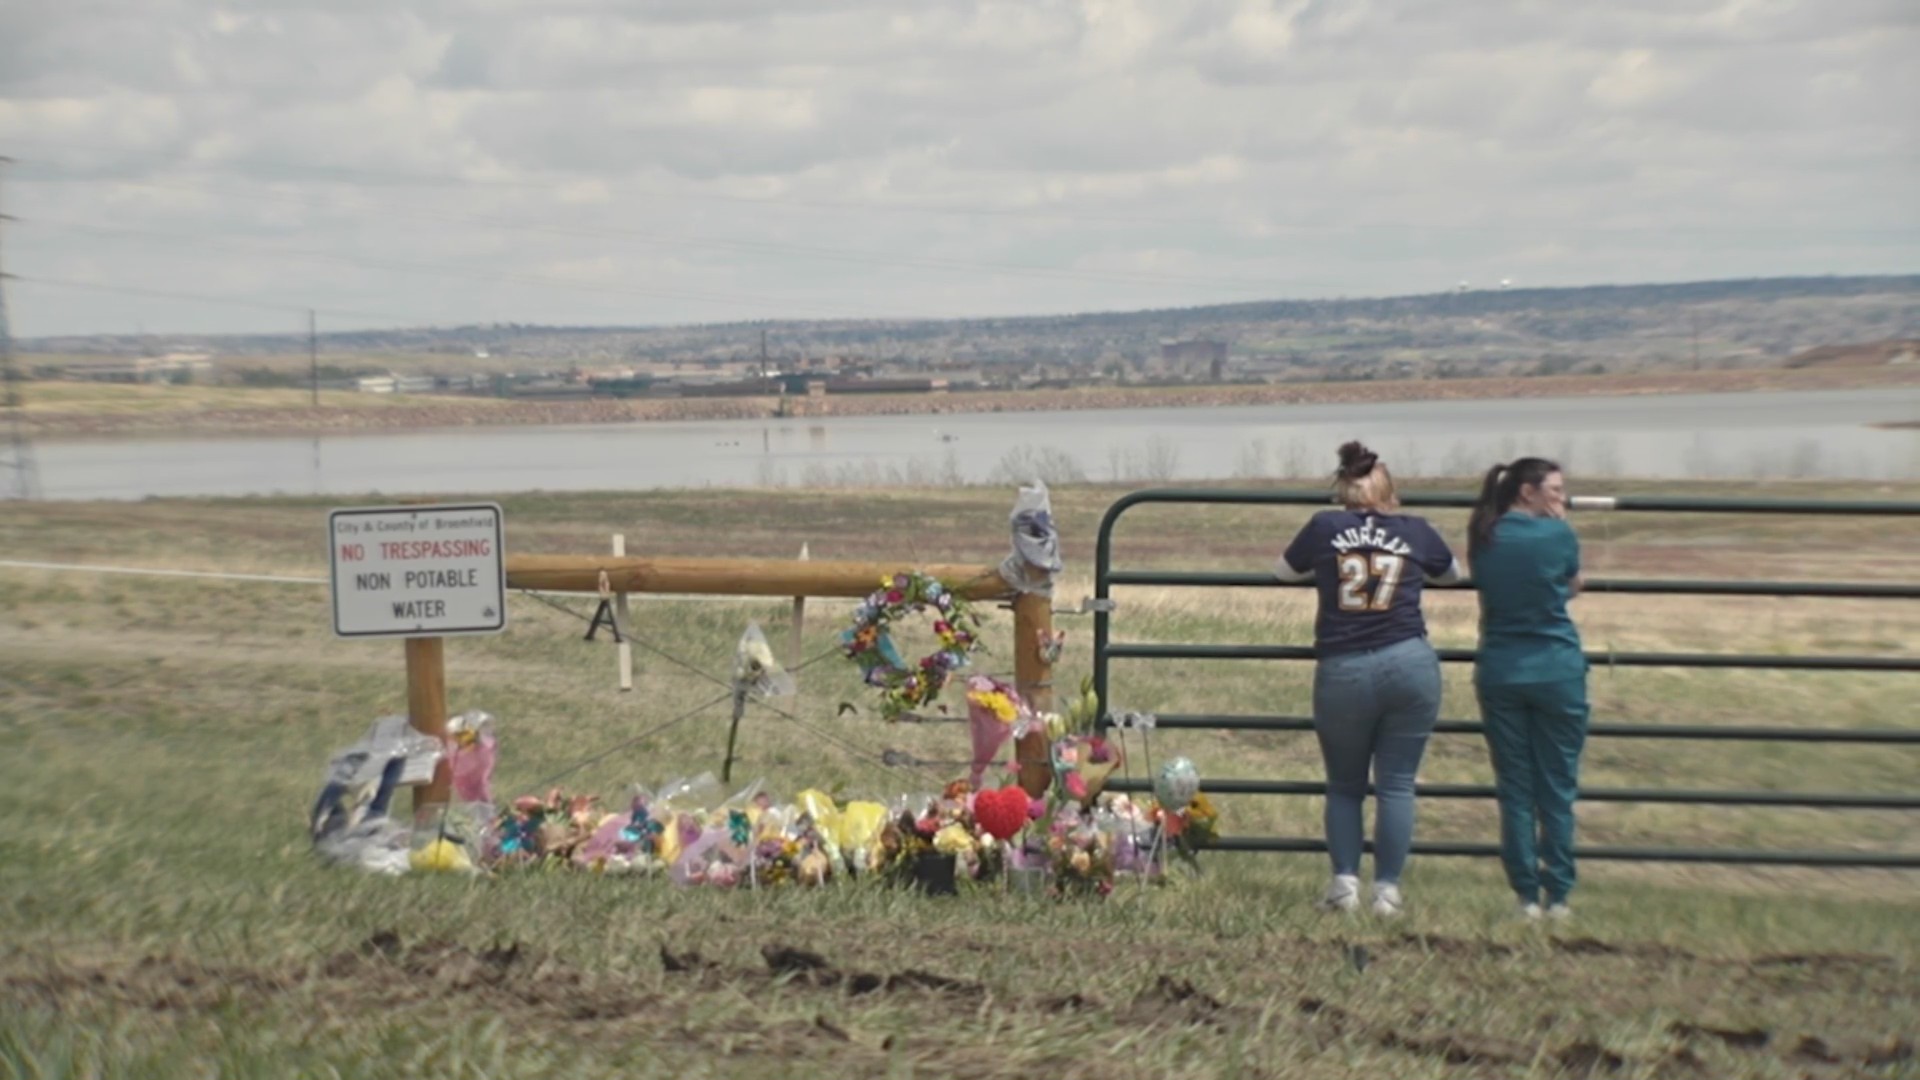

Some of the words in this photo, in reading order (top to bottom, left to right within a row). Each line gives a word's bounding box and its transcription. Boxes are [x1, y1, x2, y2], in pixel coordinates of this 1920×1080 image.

[337, 522, 358, 535] City
[363, 521, 373, 532] &
[378, 520, 414, 533] County
[418, 519, 429, 530] of
[435, 518, 493, 530] Broomfield
[341, 544, 365, 561] NO
[379, 539, 490, 560] TRESPASSING
[1331, 527, 1411, 554] MURRAY
[356, 572, 391, 591] NON
[404, 568, 478, 589] POTABLE
[1337, 554, 1404, 611] 27
[391, 599, 446, 619] WATER
